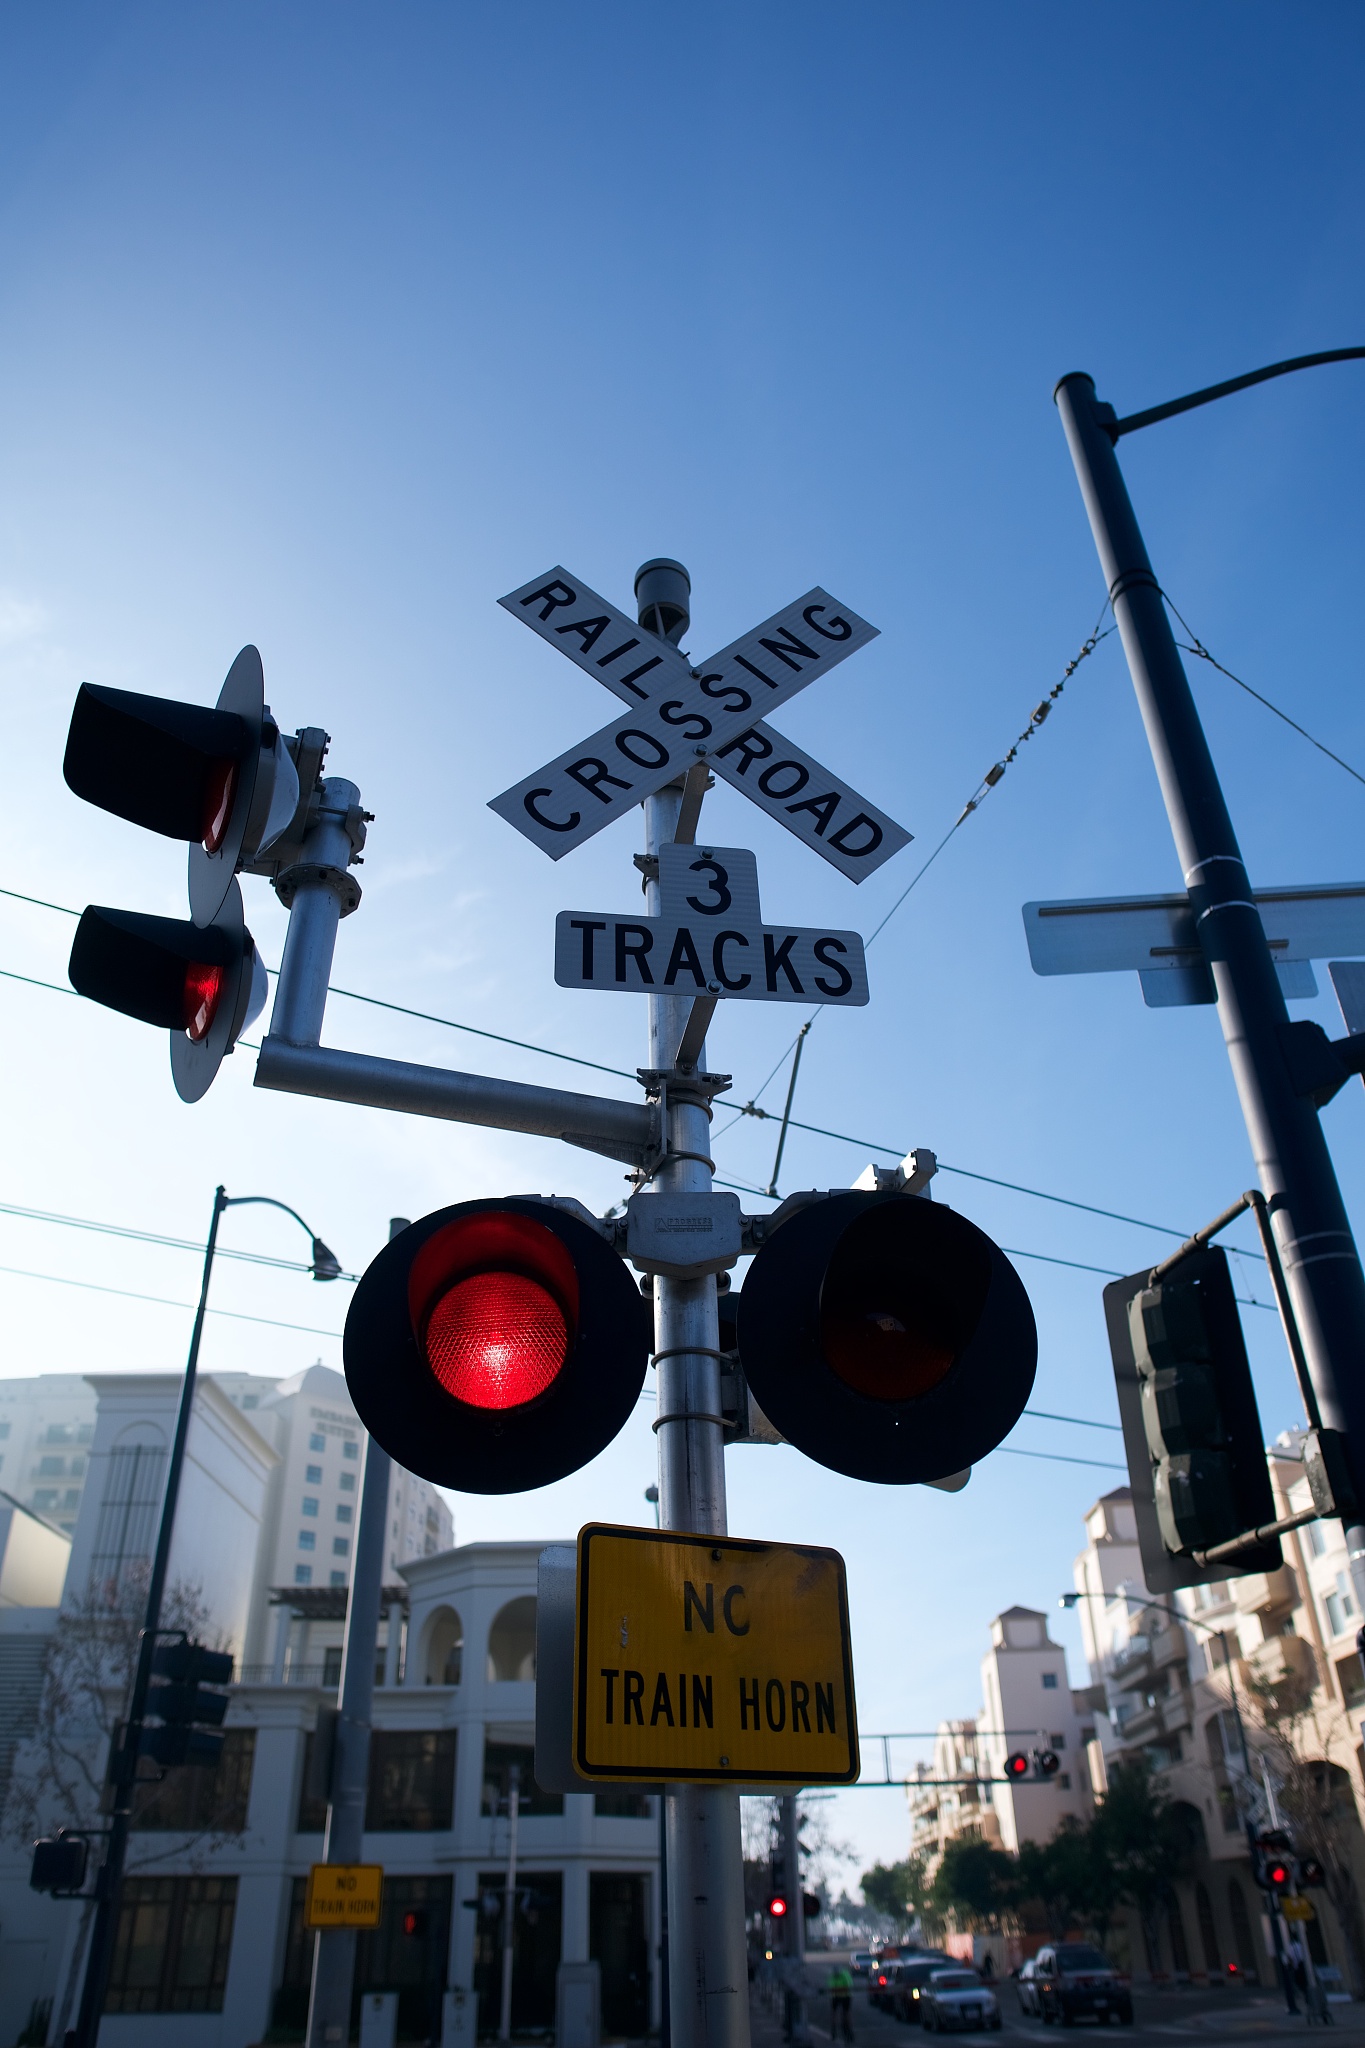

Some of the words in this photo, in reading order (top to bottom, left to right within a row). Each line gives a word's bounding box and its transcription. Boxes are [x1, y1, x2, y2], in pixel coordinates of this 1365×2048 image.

[519, 579, 664, 700] RAIL
[715, 727, 883, 858] ROAD
[523, 604, 853, 833] CROSSING
[685, 860, 732, 916] 3
[569, 919, 853, 998] TRACKS
[600, 1668, 714, 1729] TRAIN
[739, 1677, 836, 1734] HORN
